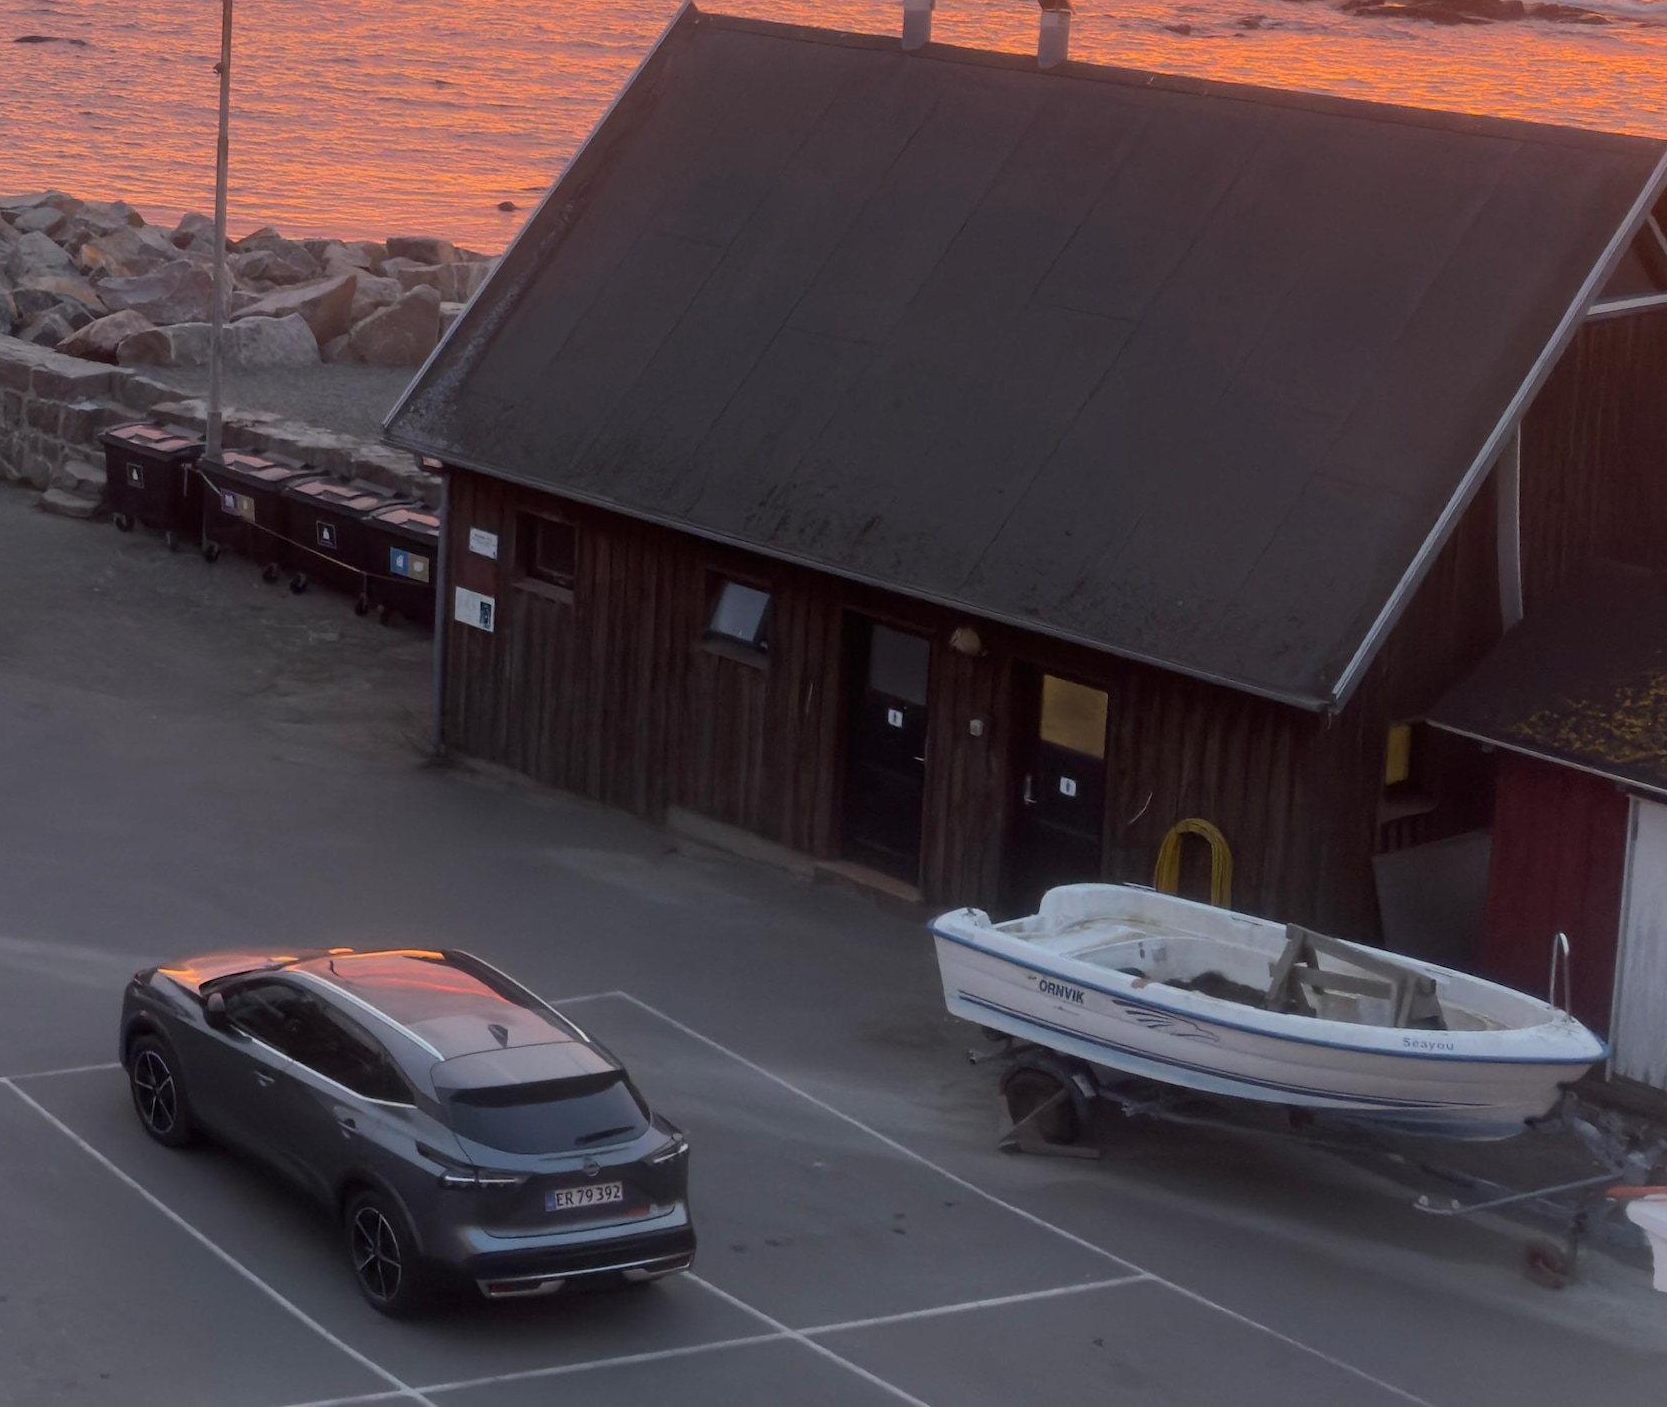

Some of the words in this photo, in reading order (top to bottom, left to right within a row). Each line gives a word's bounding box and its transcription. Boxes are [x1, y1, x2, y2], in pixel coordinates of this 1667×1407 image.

[1403, 1037, 1454, 1051] Seayou
[556, 1192, 574, 1207] ER
[577, 1190, 594, 1203] 79
[596, 1185, 621, 1201] 392
